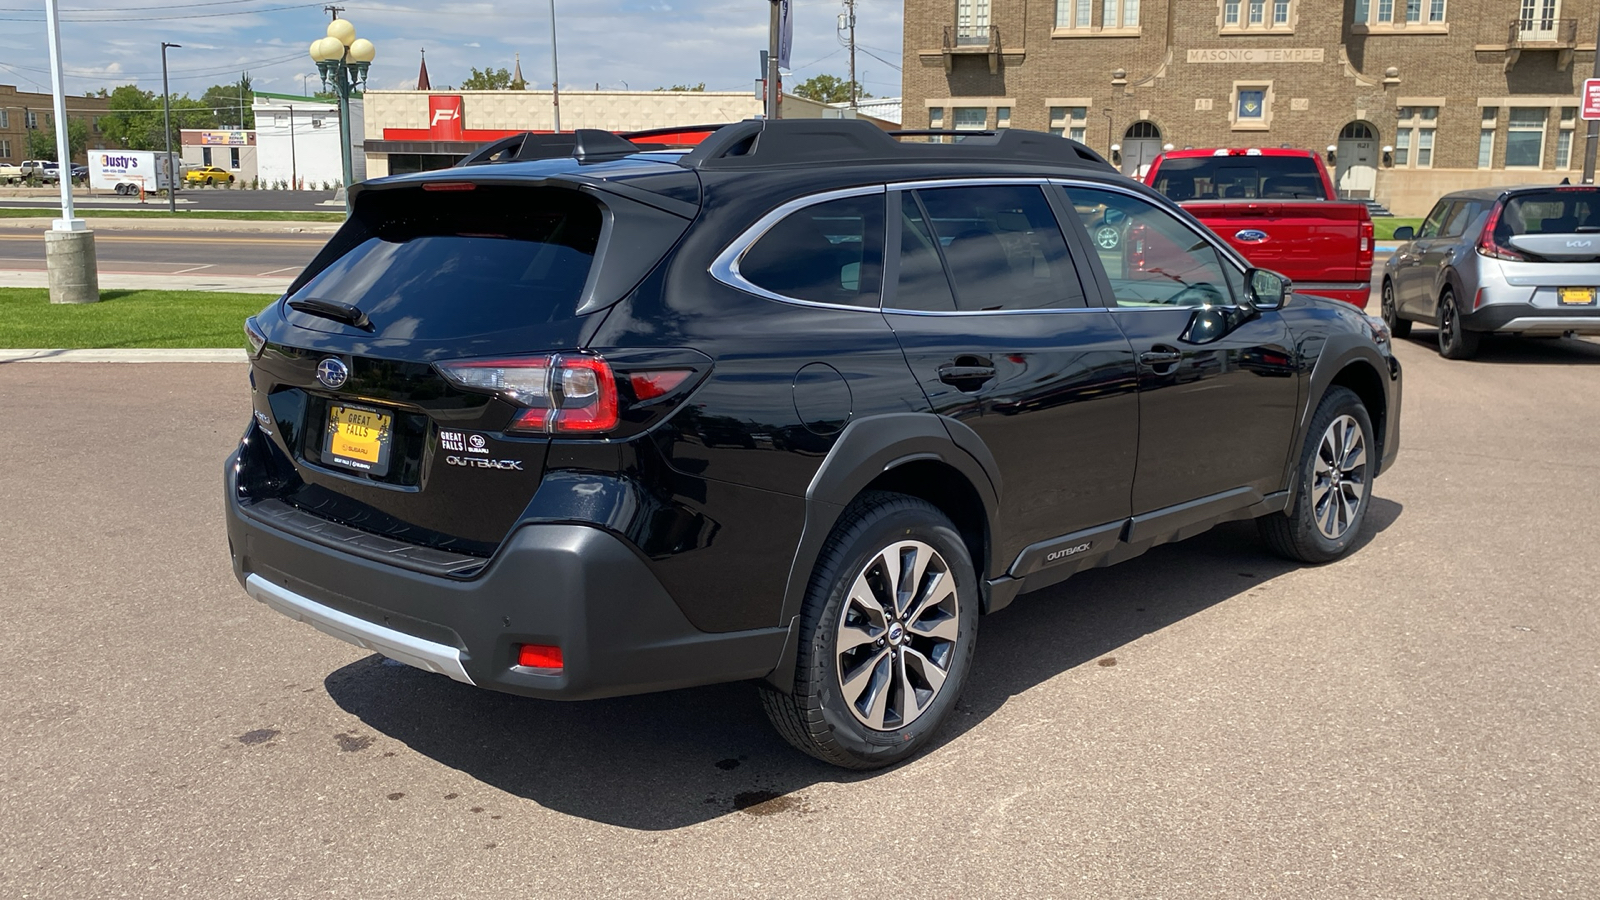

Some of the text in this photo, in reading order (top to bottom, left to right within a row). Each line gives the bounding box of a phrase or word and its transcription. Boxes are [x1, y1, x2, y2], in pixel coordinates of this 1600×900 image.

[1189, 49, 1321, 61] MASONIC TEMPLE
[348, 413, 371, 426] GREAT
[346, 424, 369, 438] FALLS
[440, 431, 462, 442] GREAT
[348, 446, 368, 455] SUBARU
[442, 440, 464, 451] FALLS
[446, 455, 524, 471] OUTBACK
[1047, 542, 1091, 561] OUTBACK
